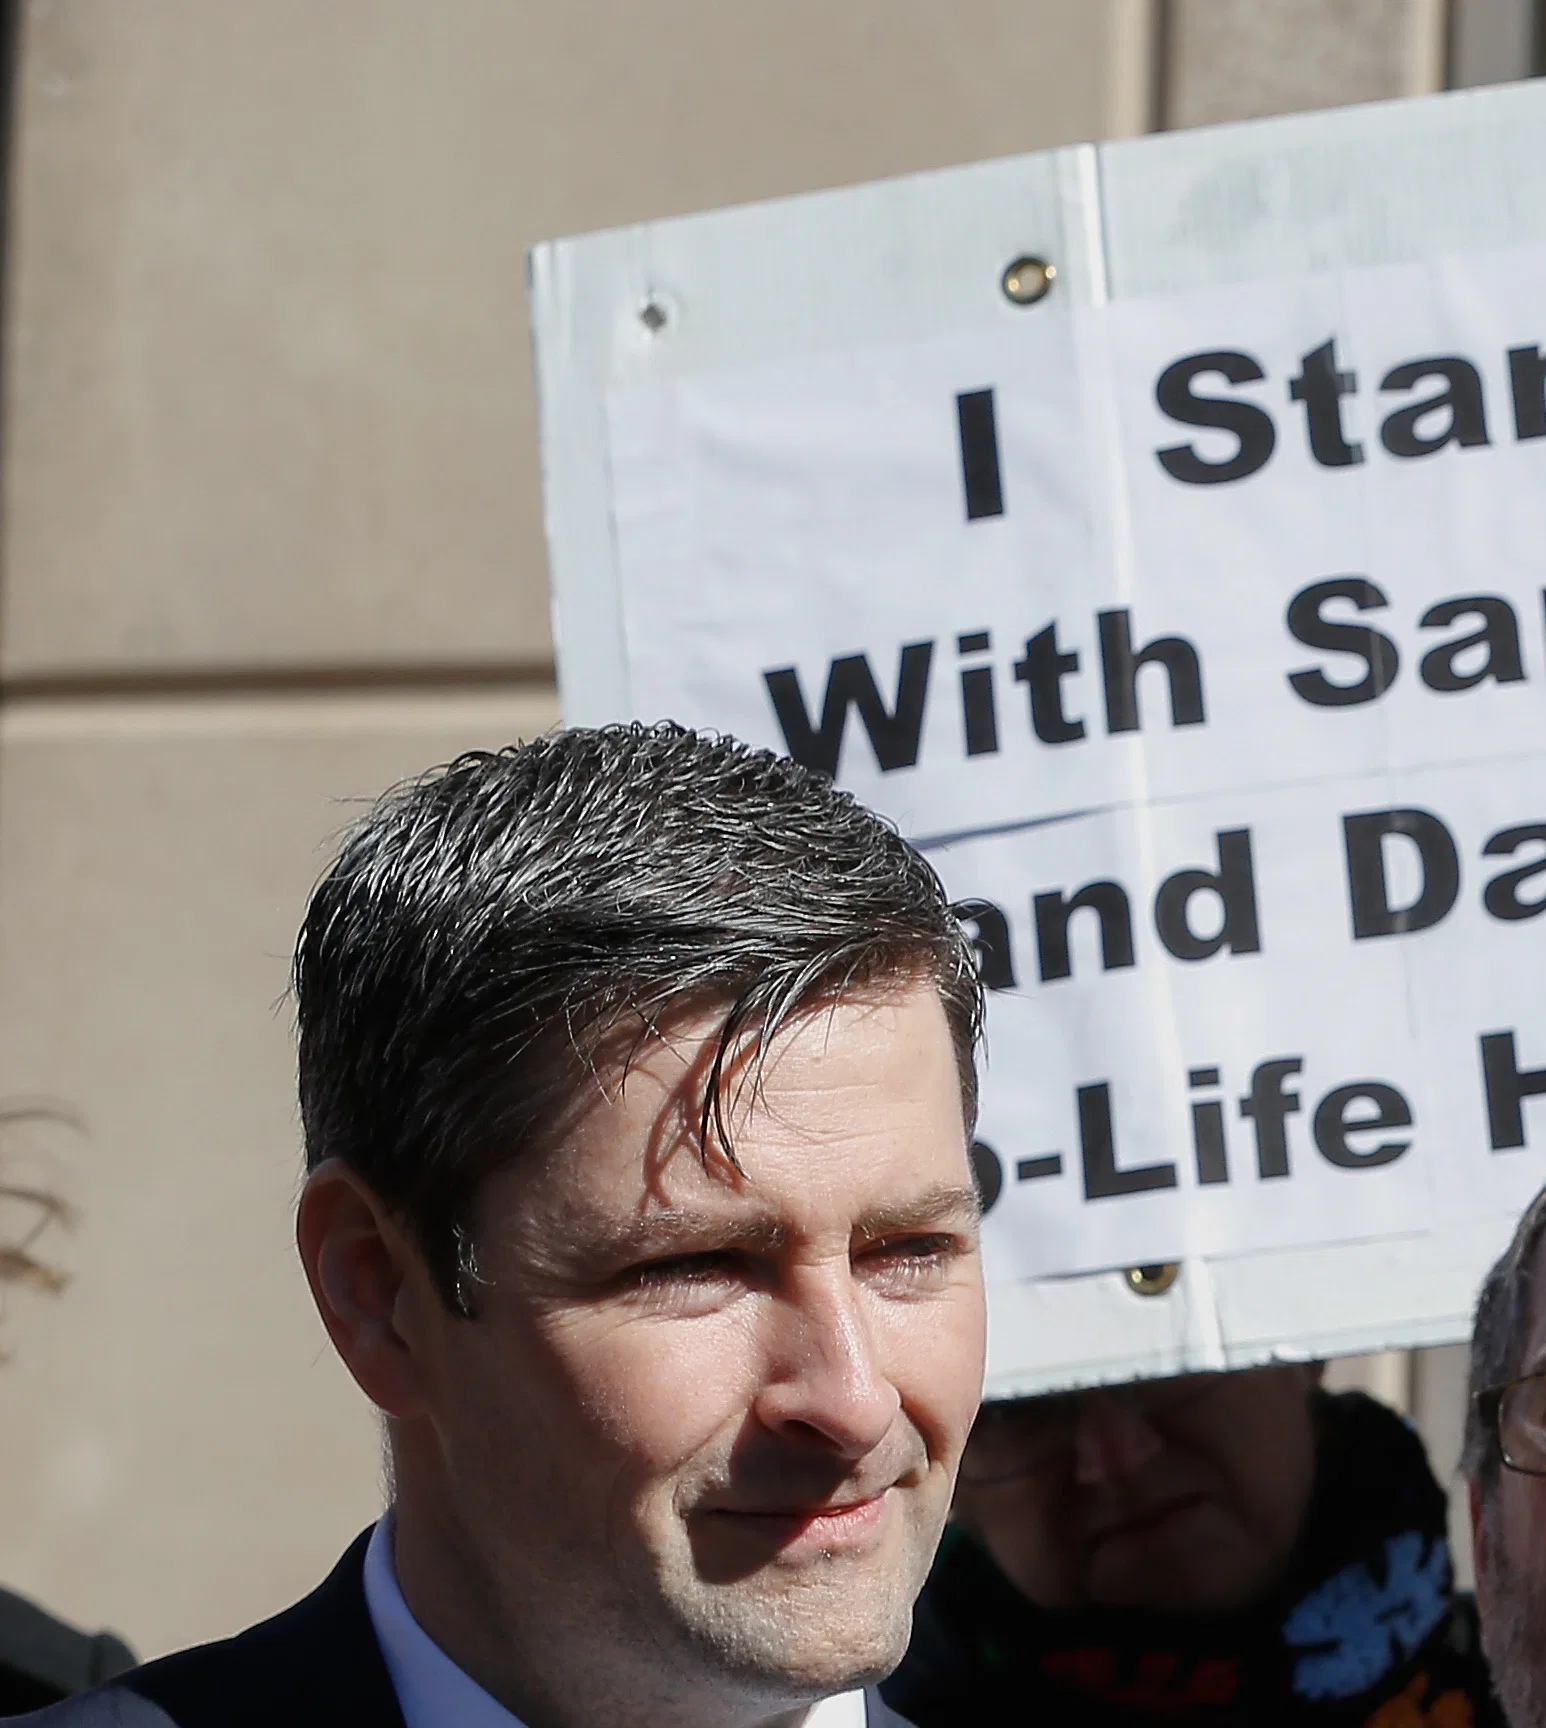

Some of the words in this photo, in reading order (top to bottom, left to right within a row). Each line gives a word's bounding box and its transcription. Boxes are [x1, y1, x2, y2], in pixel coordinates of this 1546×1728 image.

[956, 388, 1005, 522] I
[764, 609, 1206, 782] With
[950, 828, 1261, 990] and
